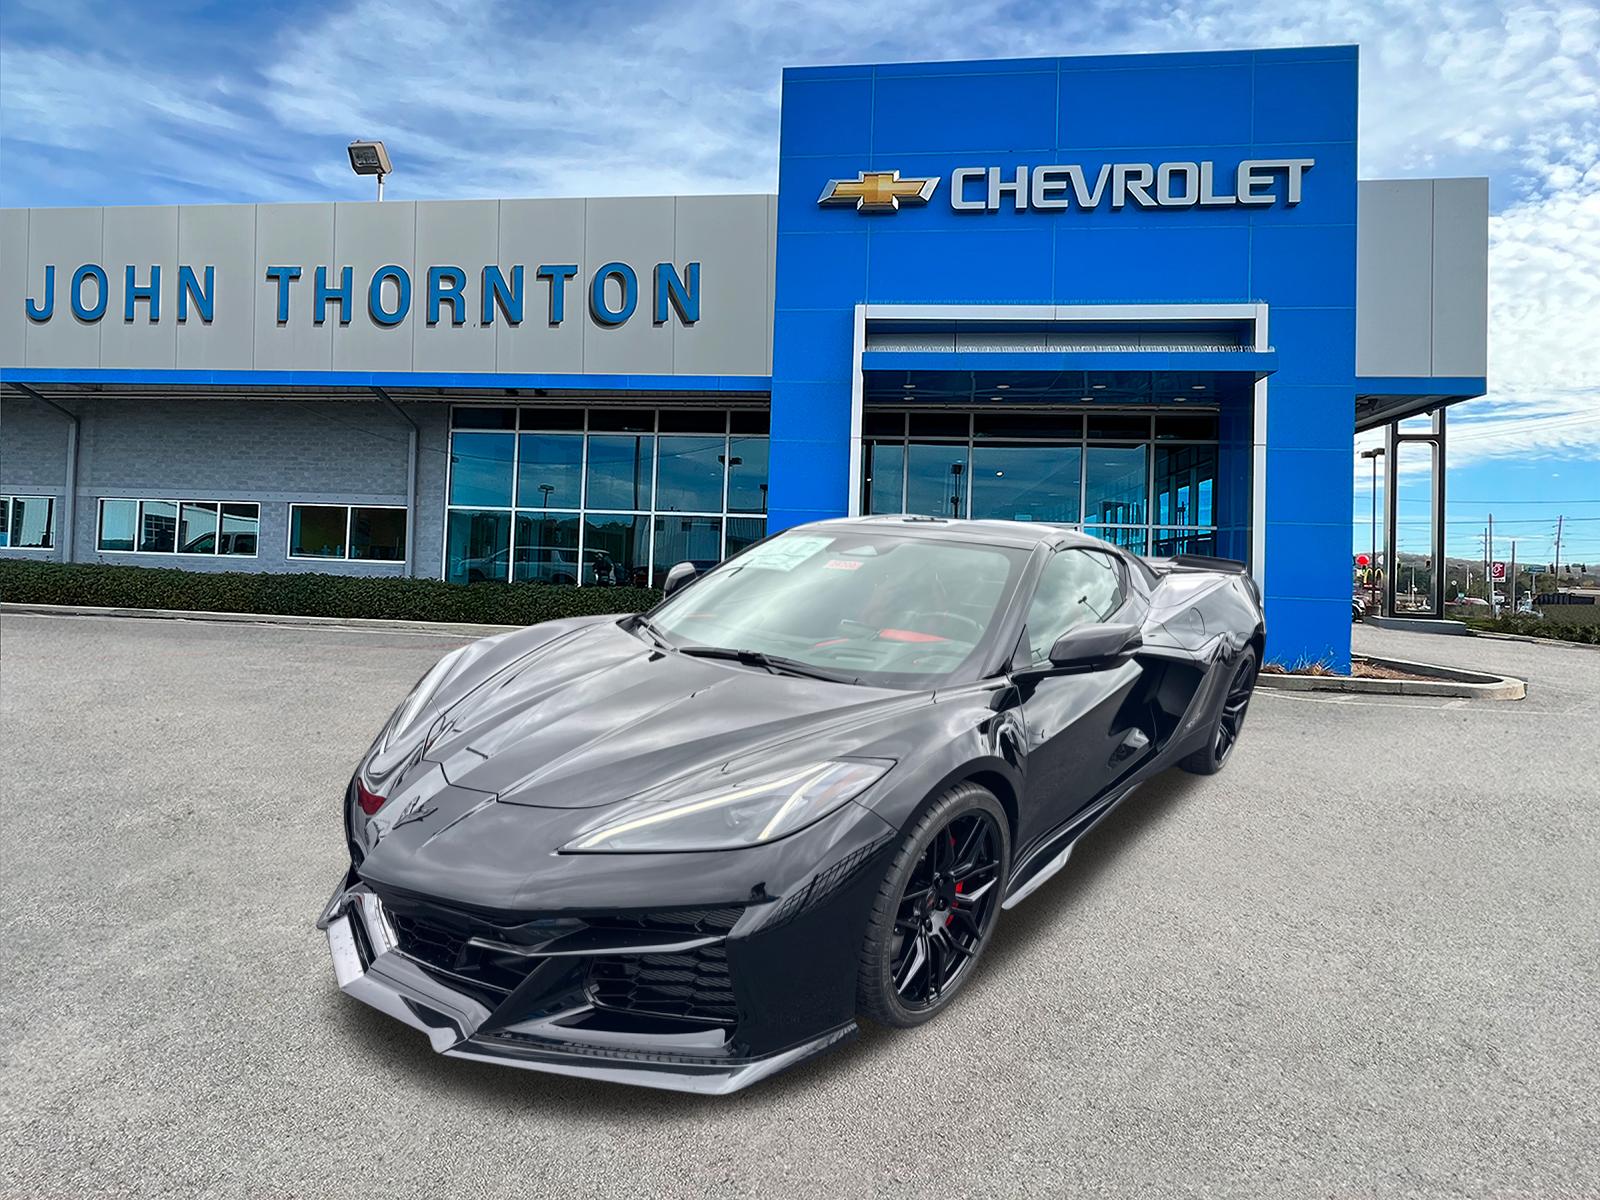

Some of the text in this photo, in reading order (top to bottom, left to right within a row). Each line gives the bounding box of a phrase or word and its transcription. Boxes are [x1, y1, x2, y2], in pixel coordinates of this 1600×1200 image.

[950, 157, 1316, 211] CHEVROLET
[25, 261, 701, 330] JOHN THORNTON
